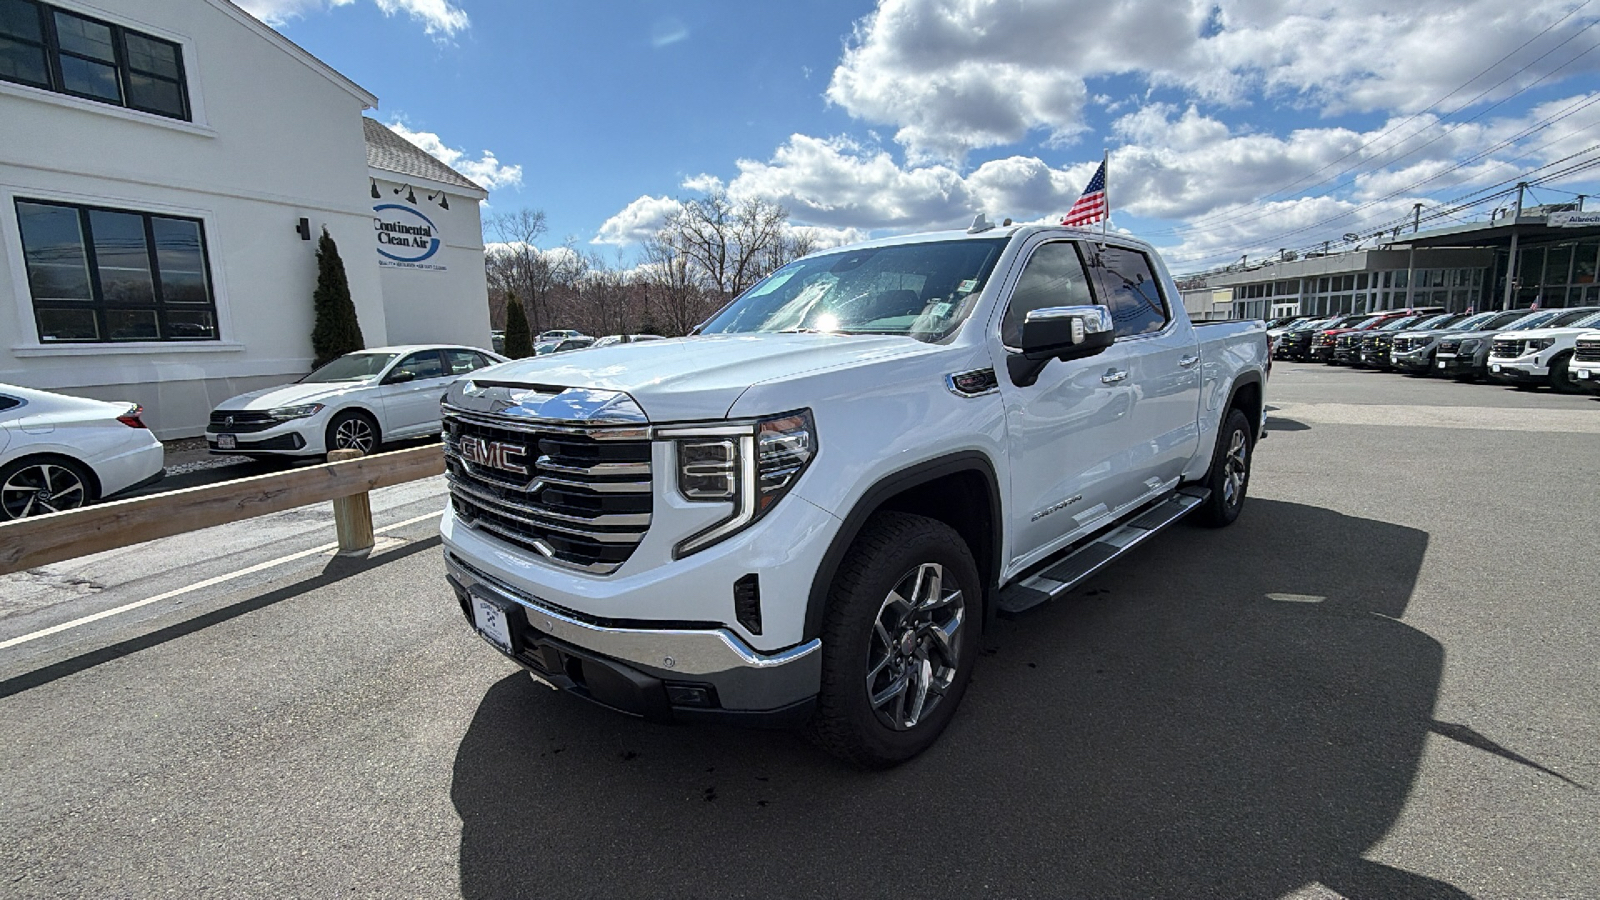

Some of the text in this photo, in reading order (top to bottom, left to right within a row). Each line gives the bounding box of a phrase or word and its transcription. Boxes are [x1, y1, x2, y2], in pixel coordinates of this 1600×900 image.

[377, 231, 429, 249] Clean Air
[460, 435, 528, 475] GMC
